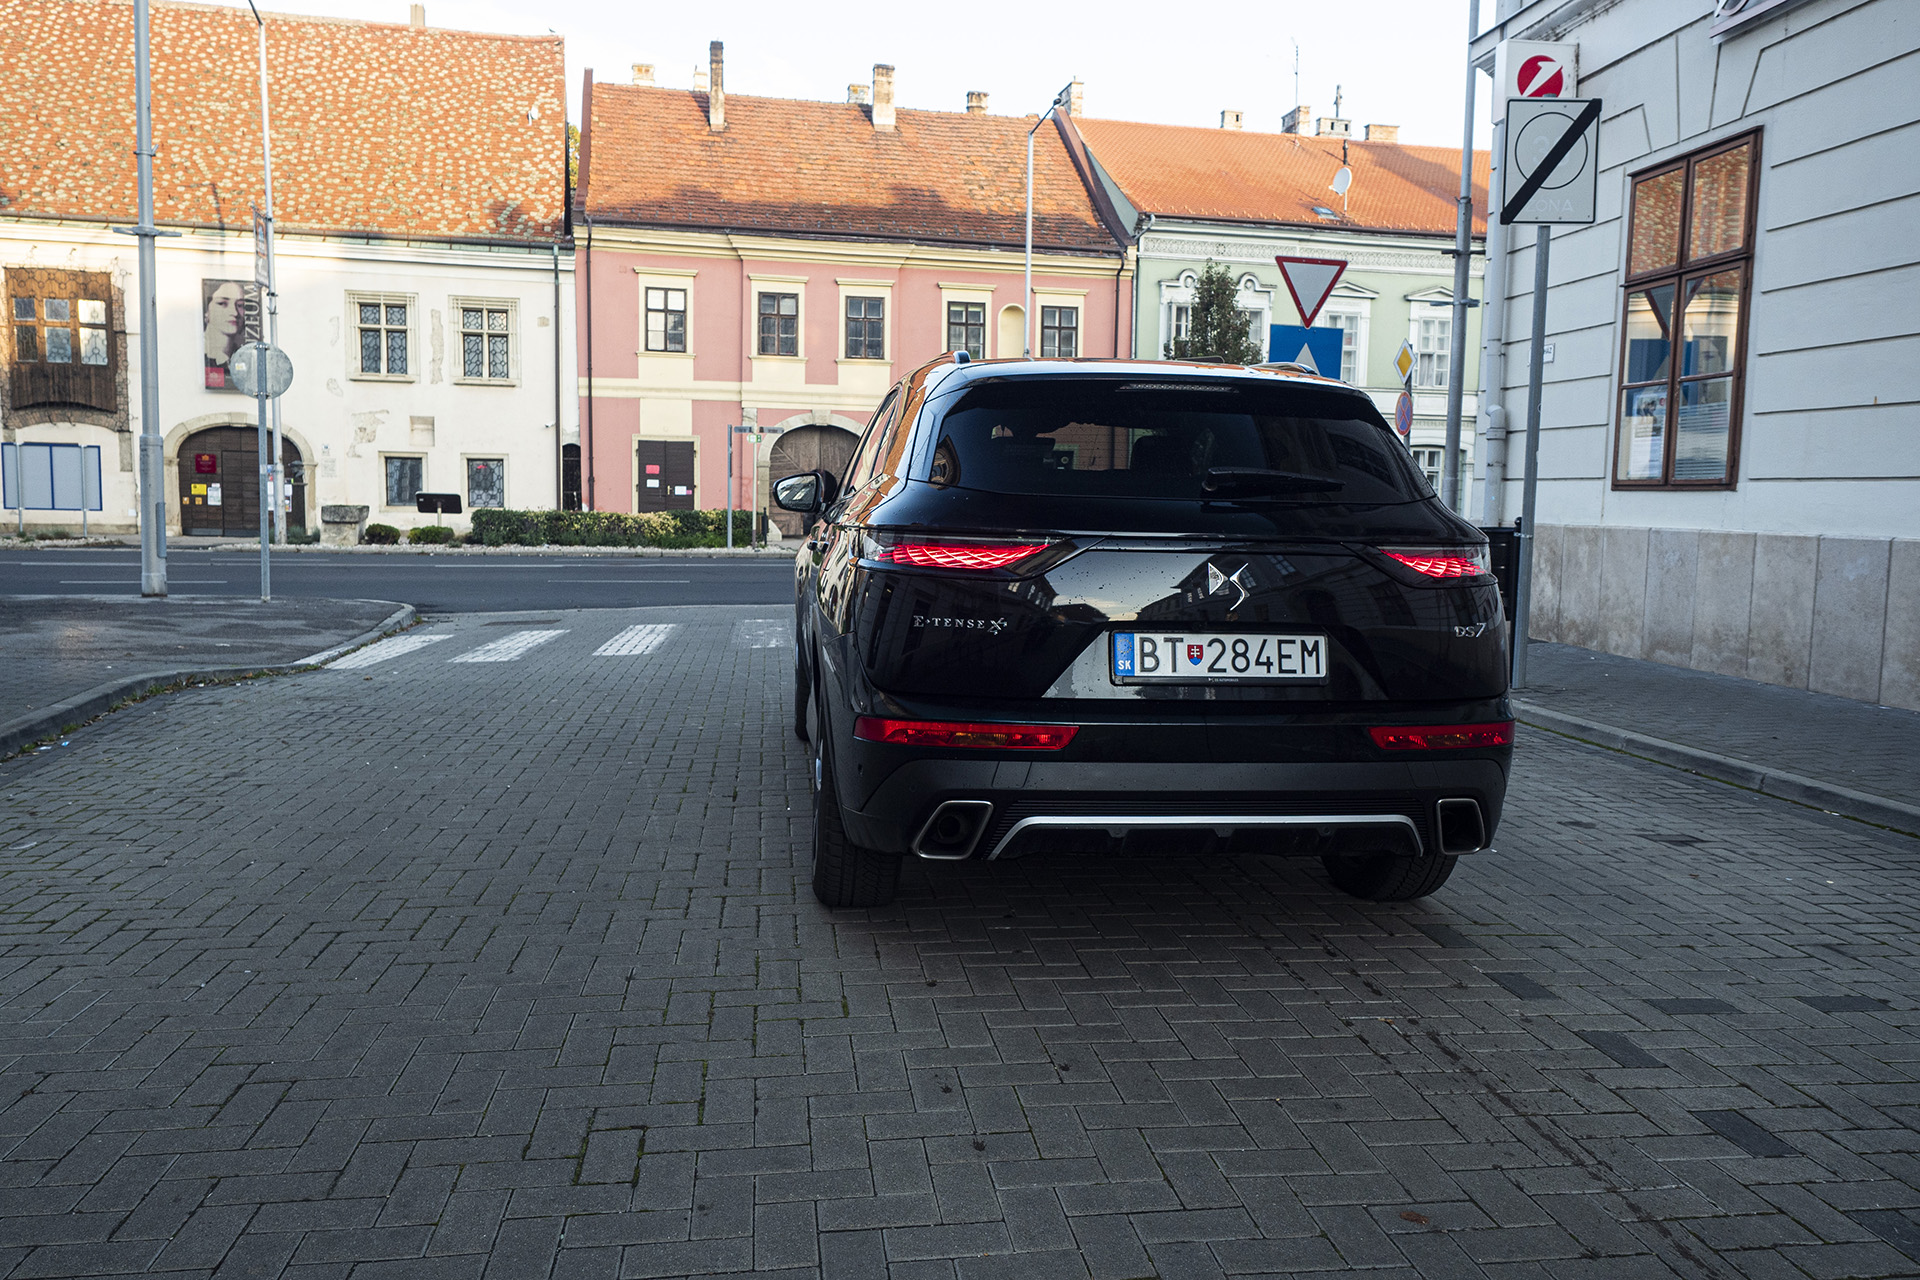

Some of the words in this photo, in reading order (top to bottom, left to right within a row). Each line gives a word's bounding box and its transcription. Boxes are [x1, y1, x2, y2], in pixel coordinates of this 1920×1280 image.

[1117, 660, 1132, 670] SK
[1138, 636, 1184, 673] BT
[1206, 637, 1321, 675] 284EM
